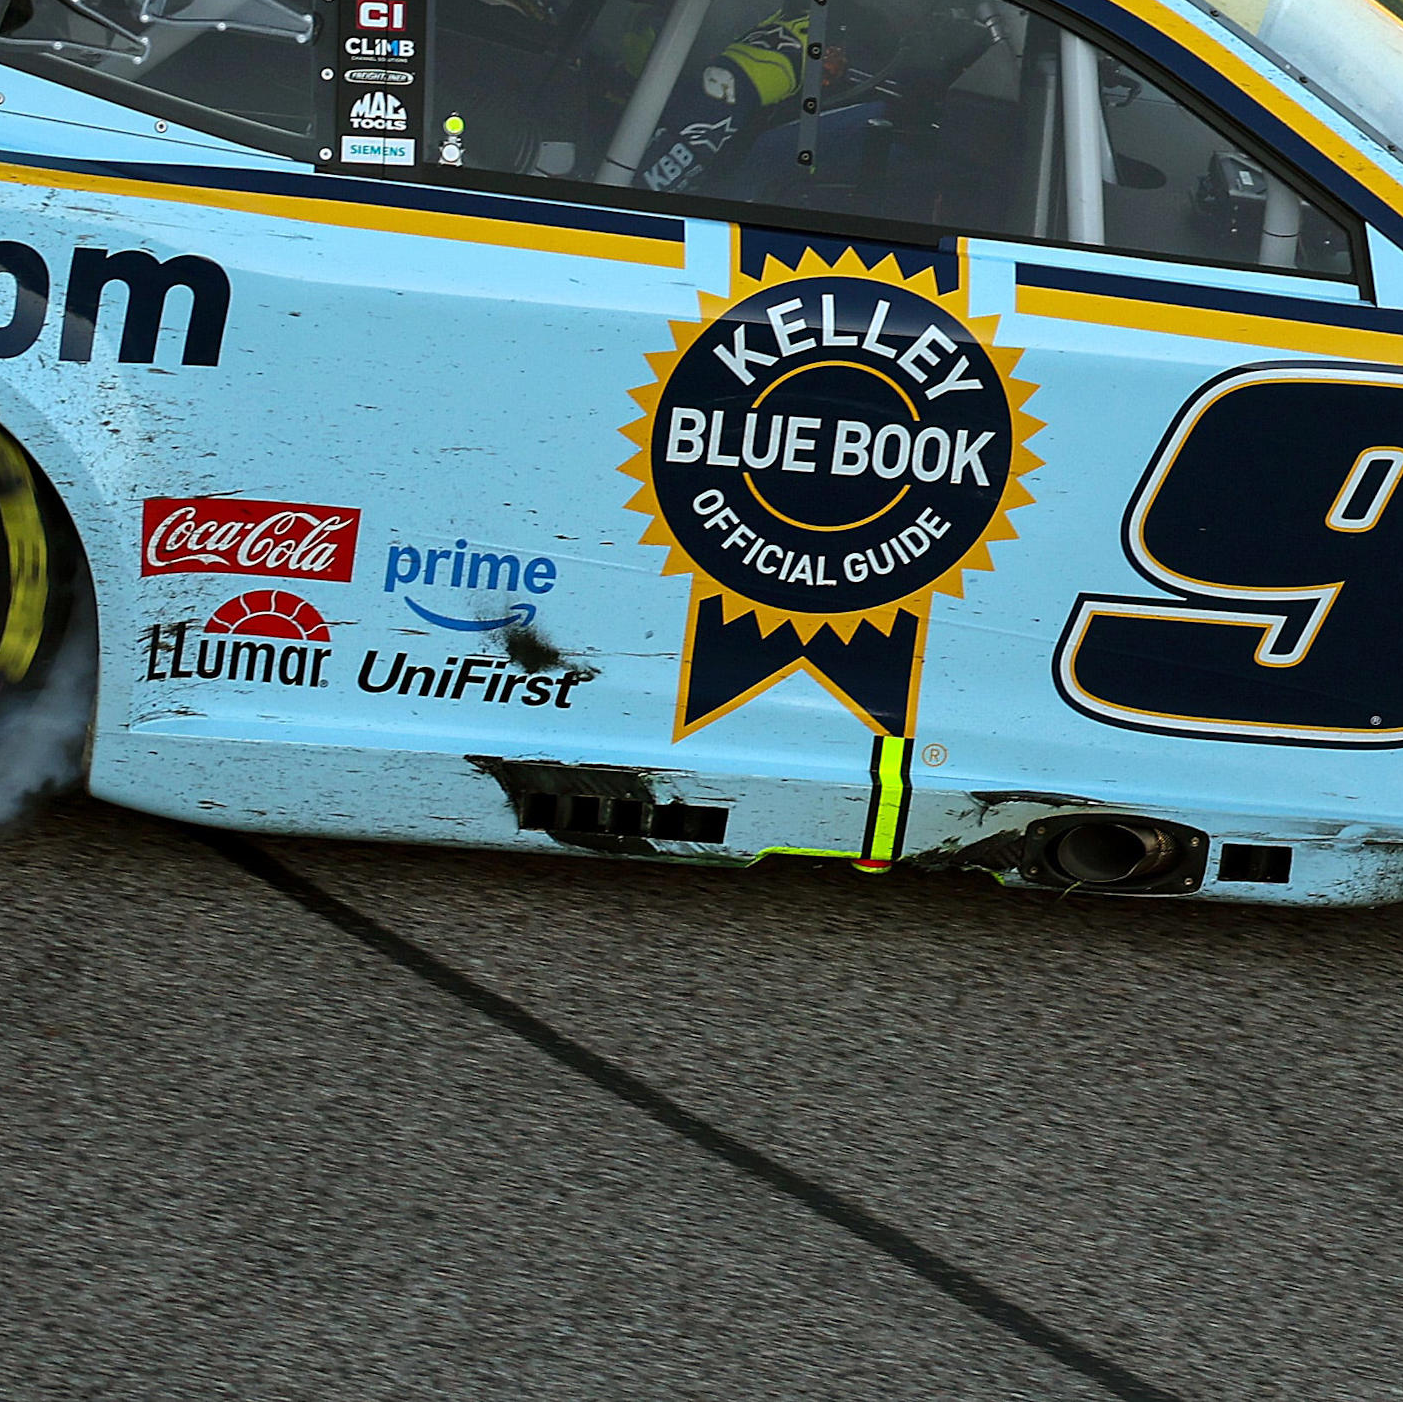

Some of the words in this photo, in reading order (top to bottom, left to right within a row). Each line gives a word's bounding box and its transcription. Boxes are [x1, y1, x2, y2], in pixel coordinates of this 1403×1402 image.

[358, 2, 404, 28] CI
[349, 119, 407, 131] TOOLS
[350, 91, 407, 120] MAC
[349, 144, 406, 157] SIEMENS
[643, 143, 694, 192] KBB
[712, 293, 984, 401] KELLEY
[665, 406, 821, 473] BLUE
[830, 419, 996, 487] BOOK
[146, 505, 355, 572] Coca-Cola
[692, 488, 838, 586] OFFICIAL
[842, 507, 952, 583] GUIDE
[383, 538, 557, 595] prime
[356, 649, 582, 709] UniFirst
